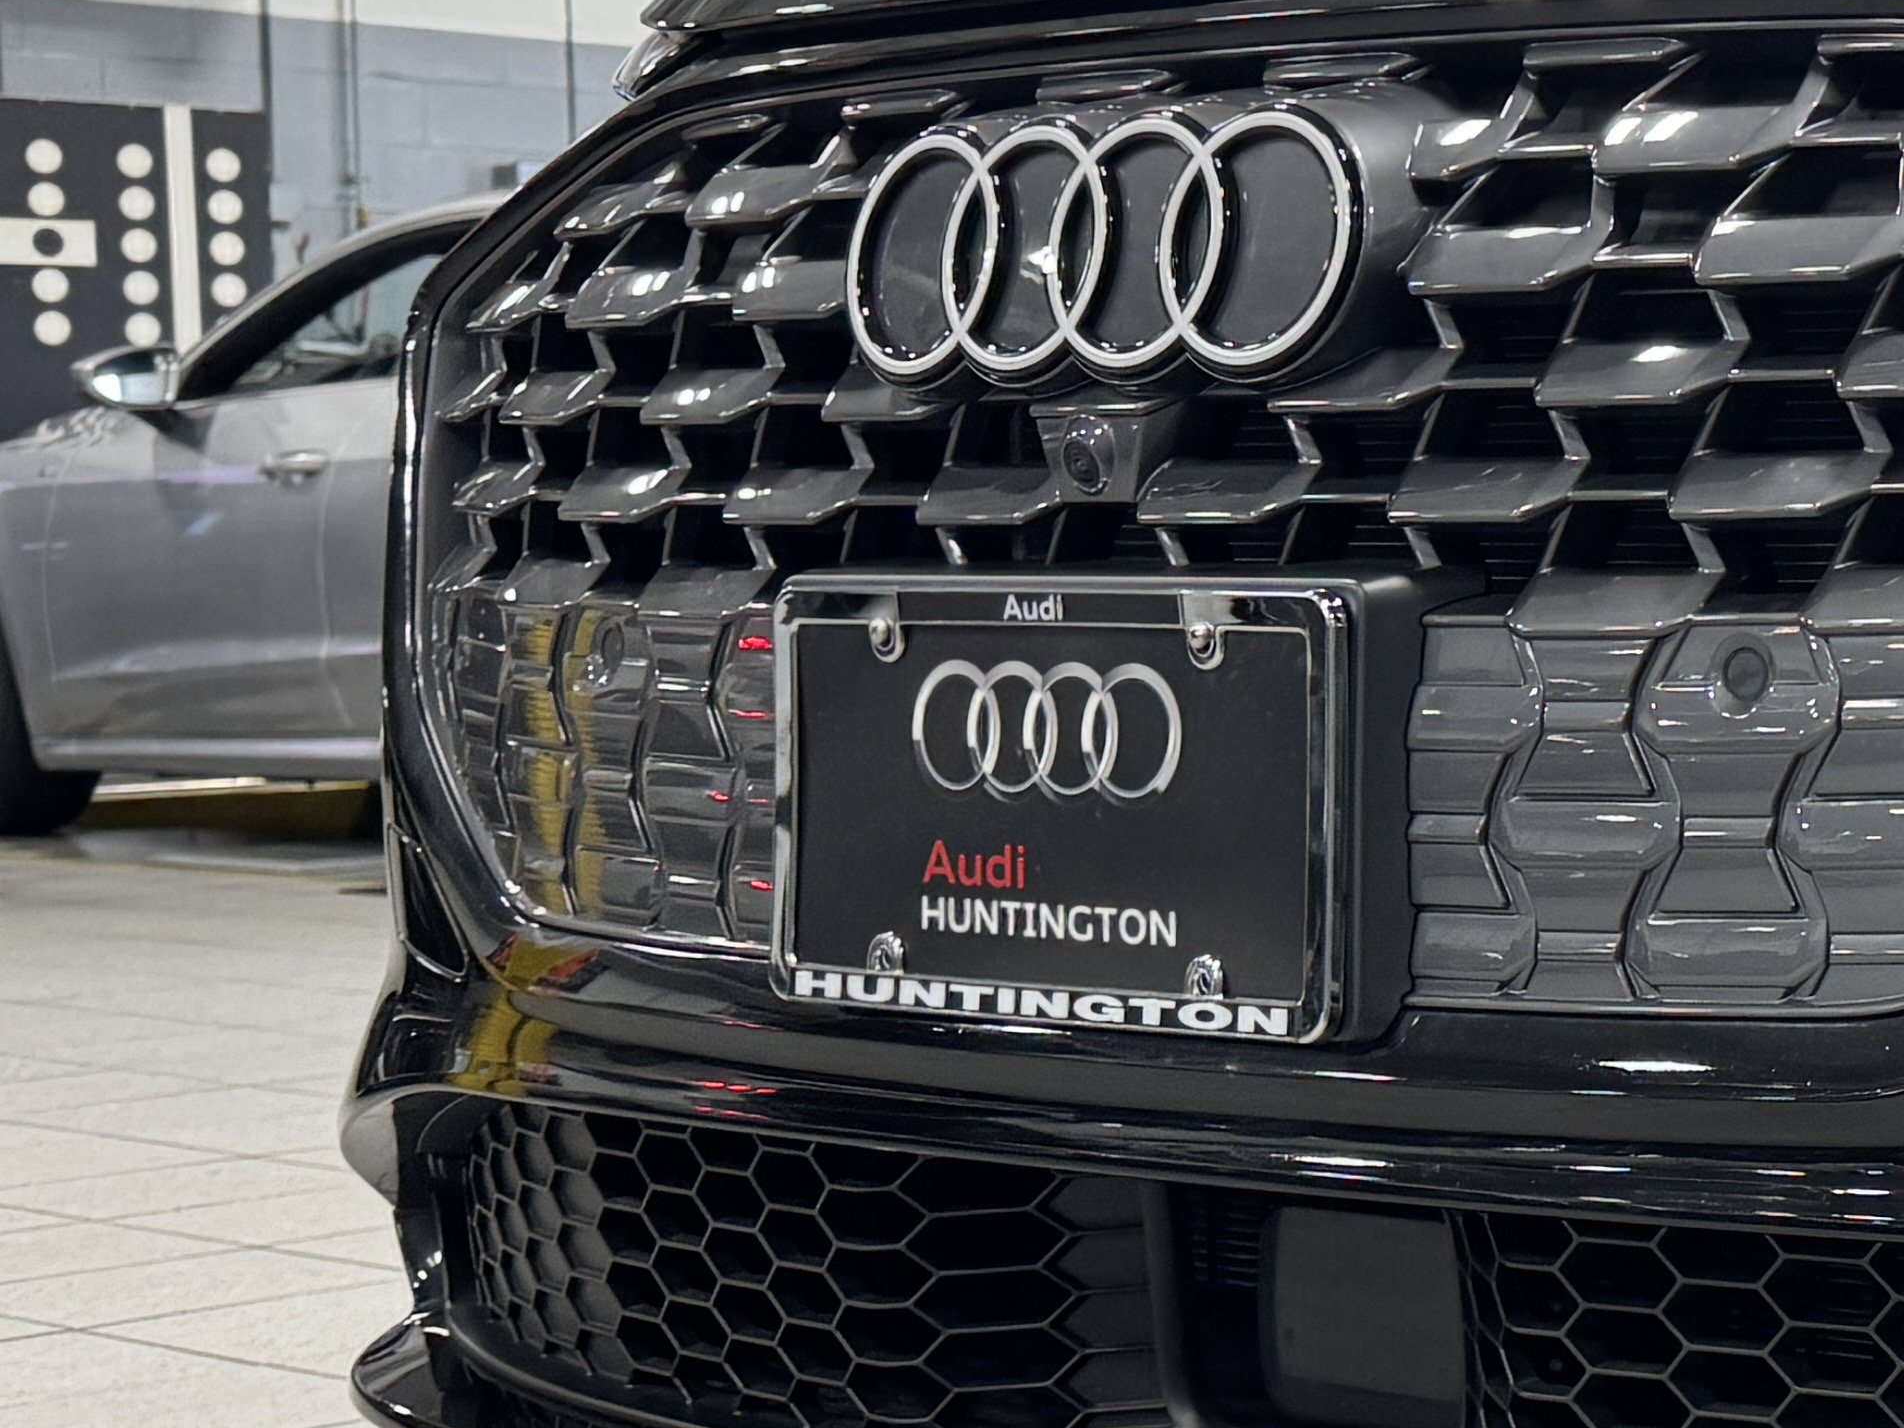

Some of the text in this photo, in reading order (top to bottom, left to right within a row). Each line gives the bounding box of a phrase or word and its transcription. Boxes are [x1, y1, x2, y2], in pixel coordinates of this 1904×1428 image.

[1003, 593, 1064, 622] Audi
[922, 839, 1026, 888] Audi
[920, 896, 1177, 947] HUNTINGTON
[795, 970, 1289, 1035] HUNTINGTON
